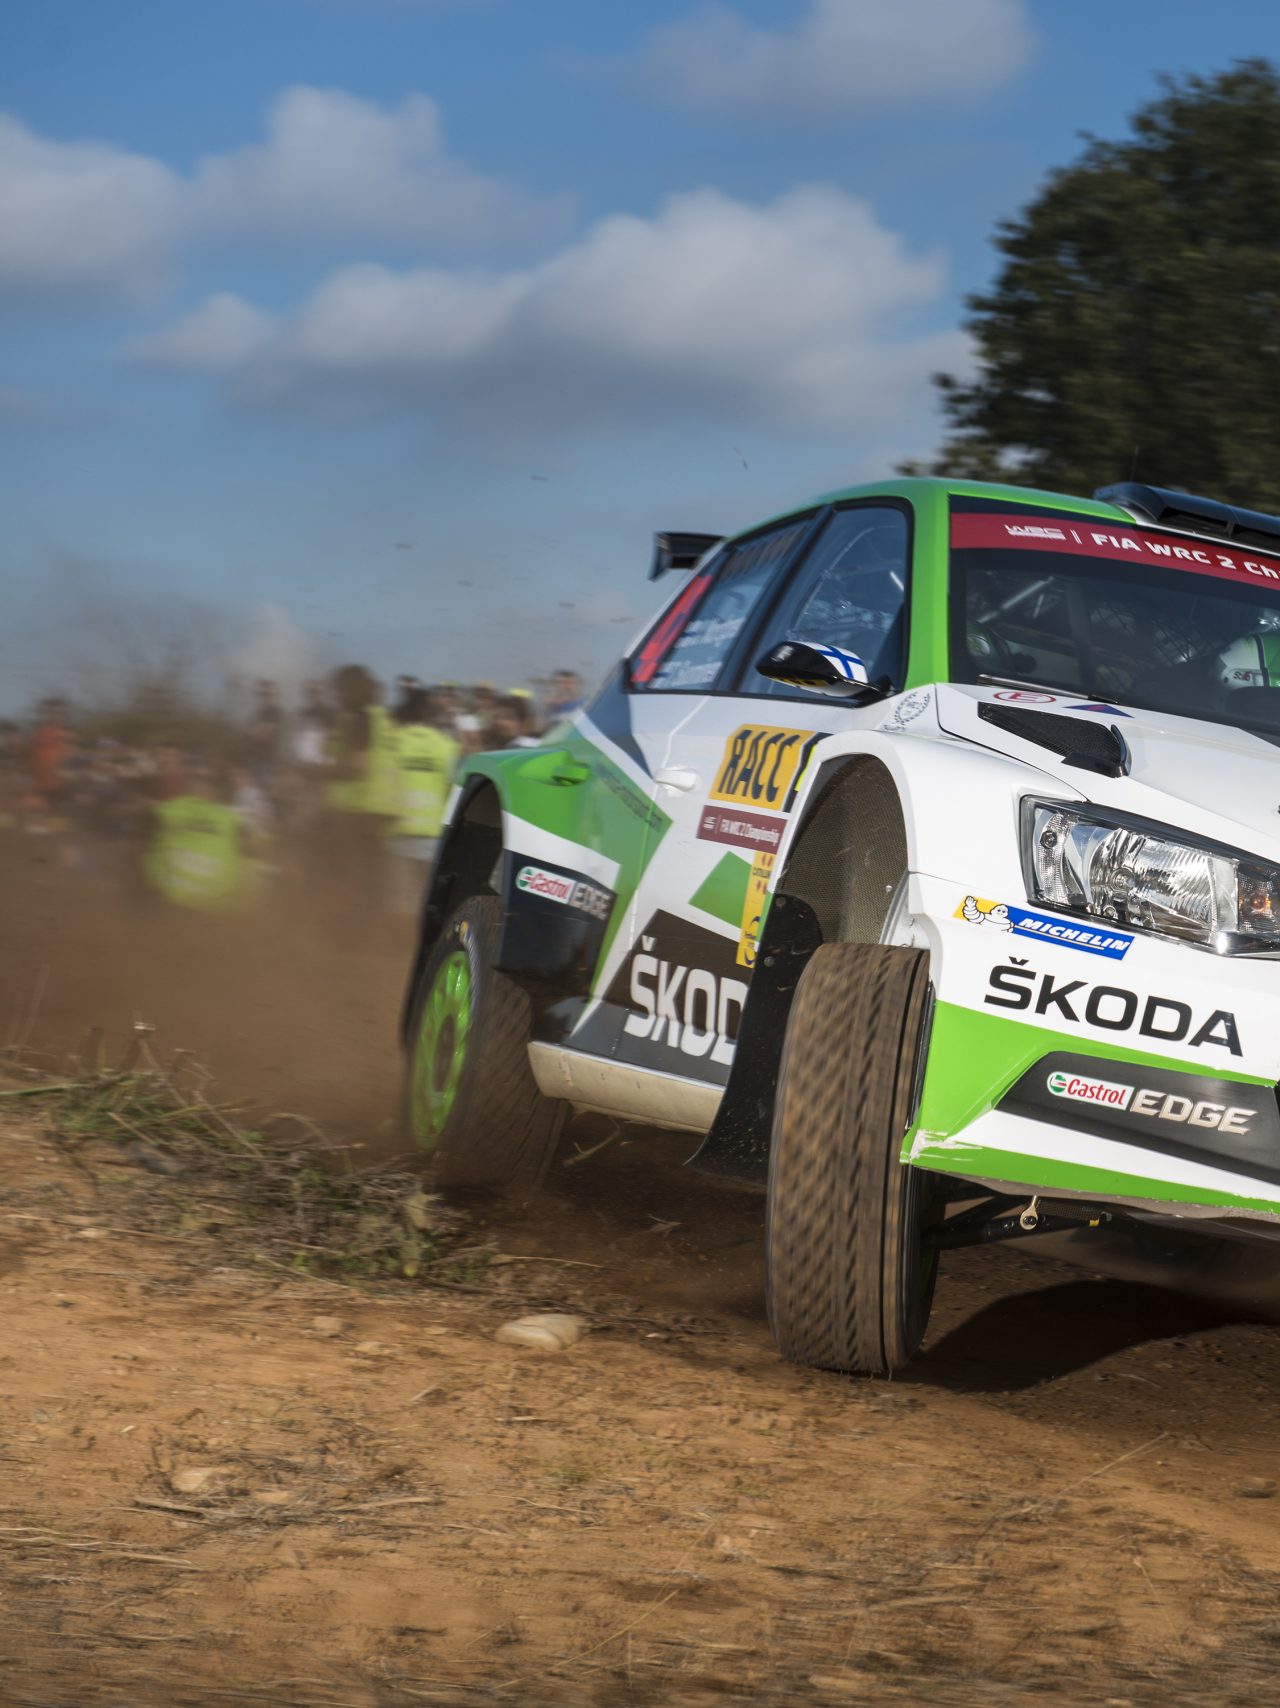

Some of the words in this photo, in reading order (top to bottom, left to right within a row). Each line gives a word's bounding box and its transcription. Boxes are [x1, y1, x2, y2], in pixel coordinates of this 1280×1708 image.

[1091, 533, 1142, 552] FIA
[1144, 541, 1211, 564] WRC
[1216, 554, 1237, 570] 2
[717, 729, 801, 803] RACC
[528, 872, 572, 900] Castrol
[569, 881, 612, 921] EDGE
[1018, 918, 1131, 951] MICHELIN
[624, 935, 748, 1065] ŠKOD
[983, 956, 1244, 1057] ŠKODA
[1066, 1075, 1127, 1106] Castrol
[1130, 1089, 1258, 1136] EDGE
